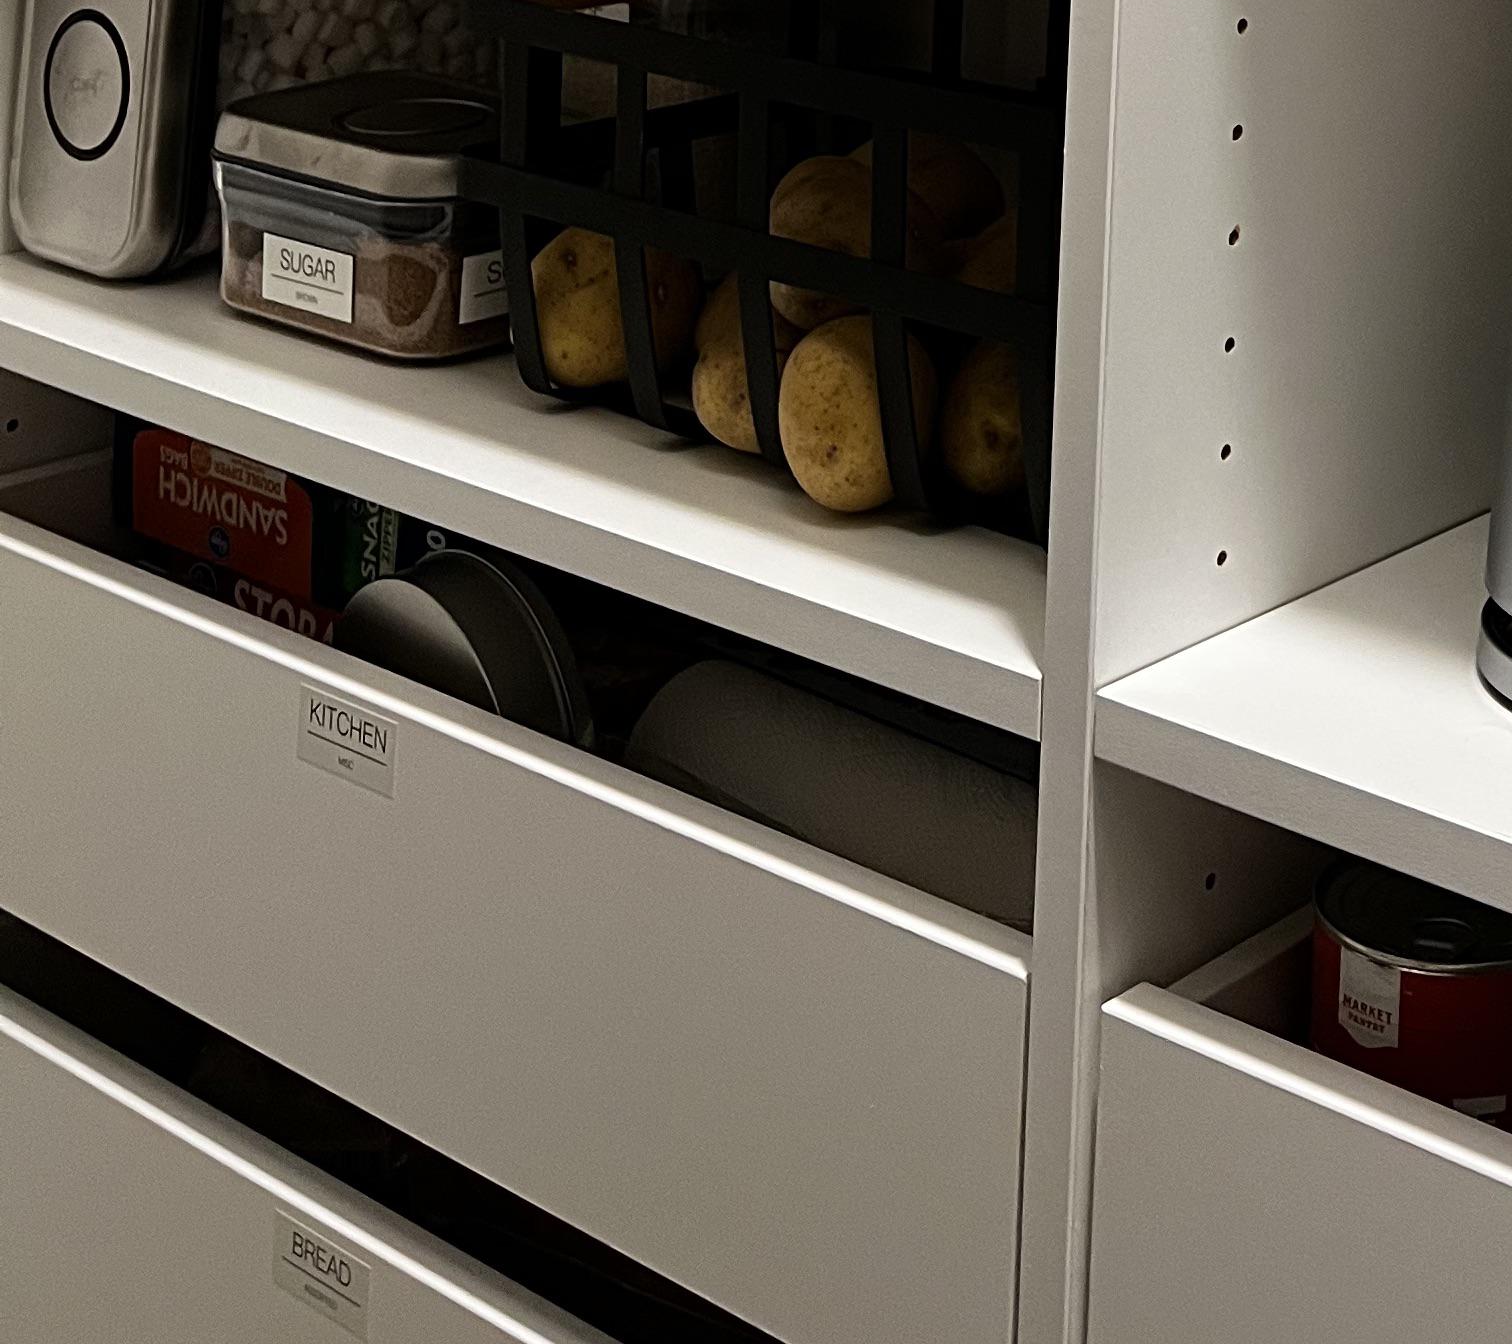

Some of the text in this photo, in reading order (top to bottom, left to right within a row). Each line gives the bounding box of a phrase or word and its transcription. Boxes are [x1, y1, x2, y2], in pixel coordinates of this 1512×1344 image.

[280, 247, 336, 284] SUGAR
[158, 464, 288, 546] SANDWICH
[309, 697, 388, 754] KITCHEN
[1342, 993, 1392, 1025] MARKET
[292, 1231, 352, 1287] BREAD
